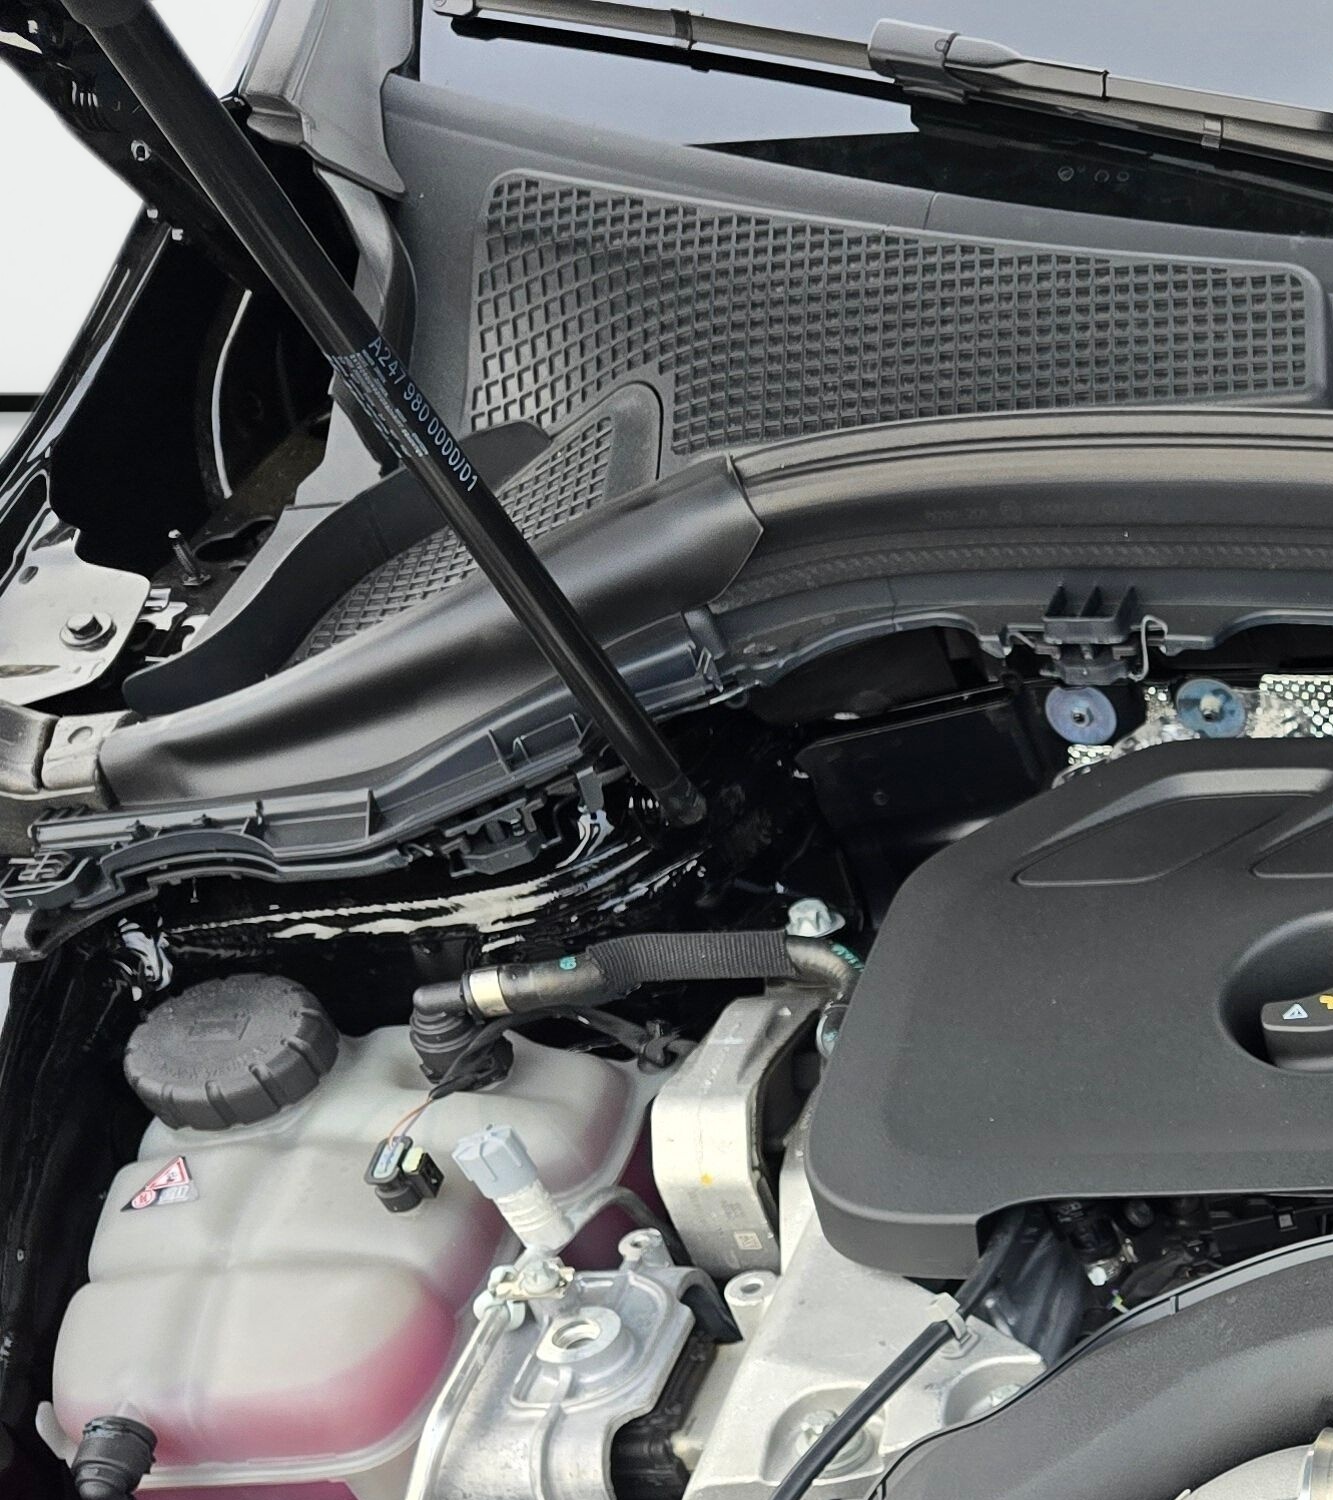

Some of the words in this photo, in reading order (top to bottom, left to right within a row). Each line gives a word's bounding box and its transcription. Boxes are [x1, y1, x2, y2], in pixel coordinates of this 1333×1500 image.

[368, 336, 406, 384] A247
[403, 382, 430, 422] 980
[427, 417, 478, 492] 0000/01
